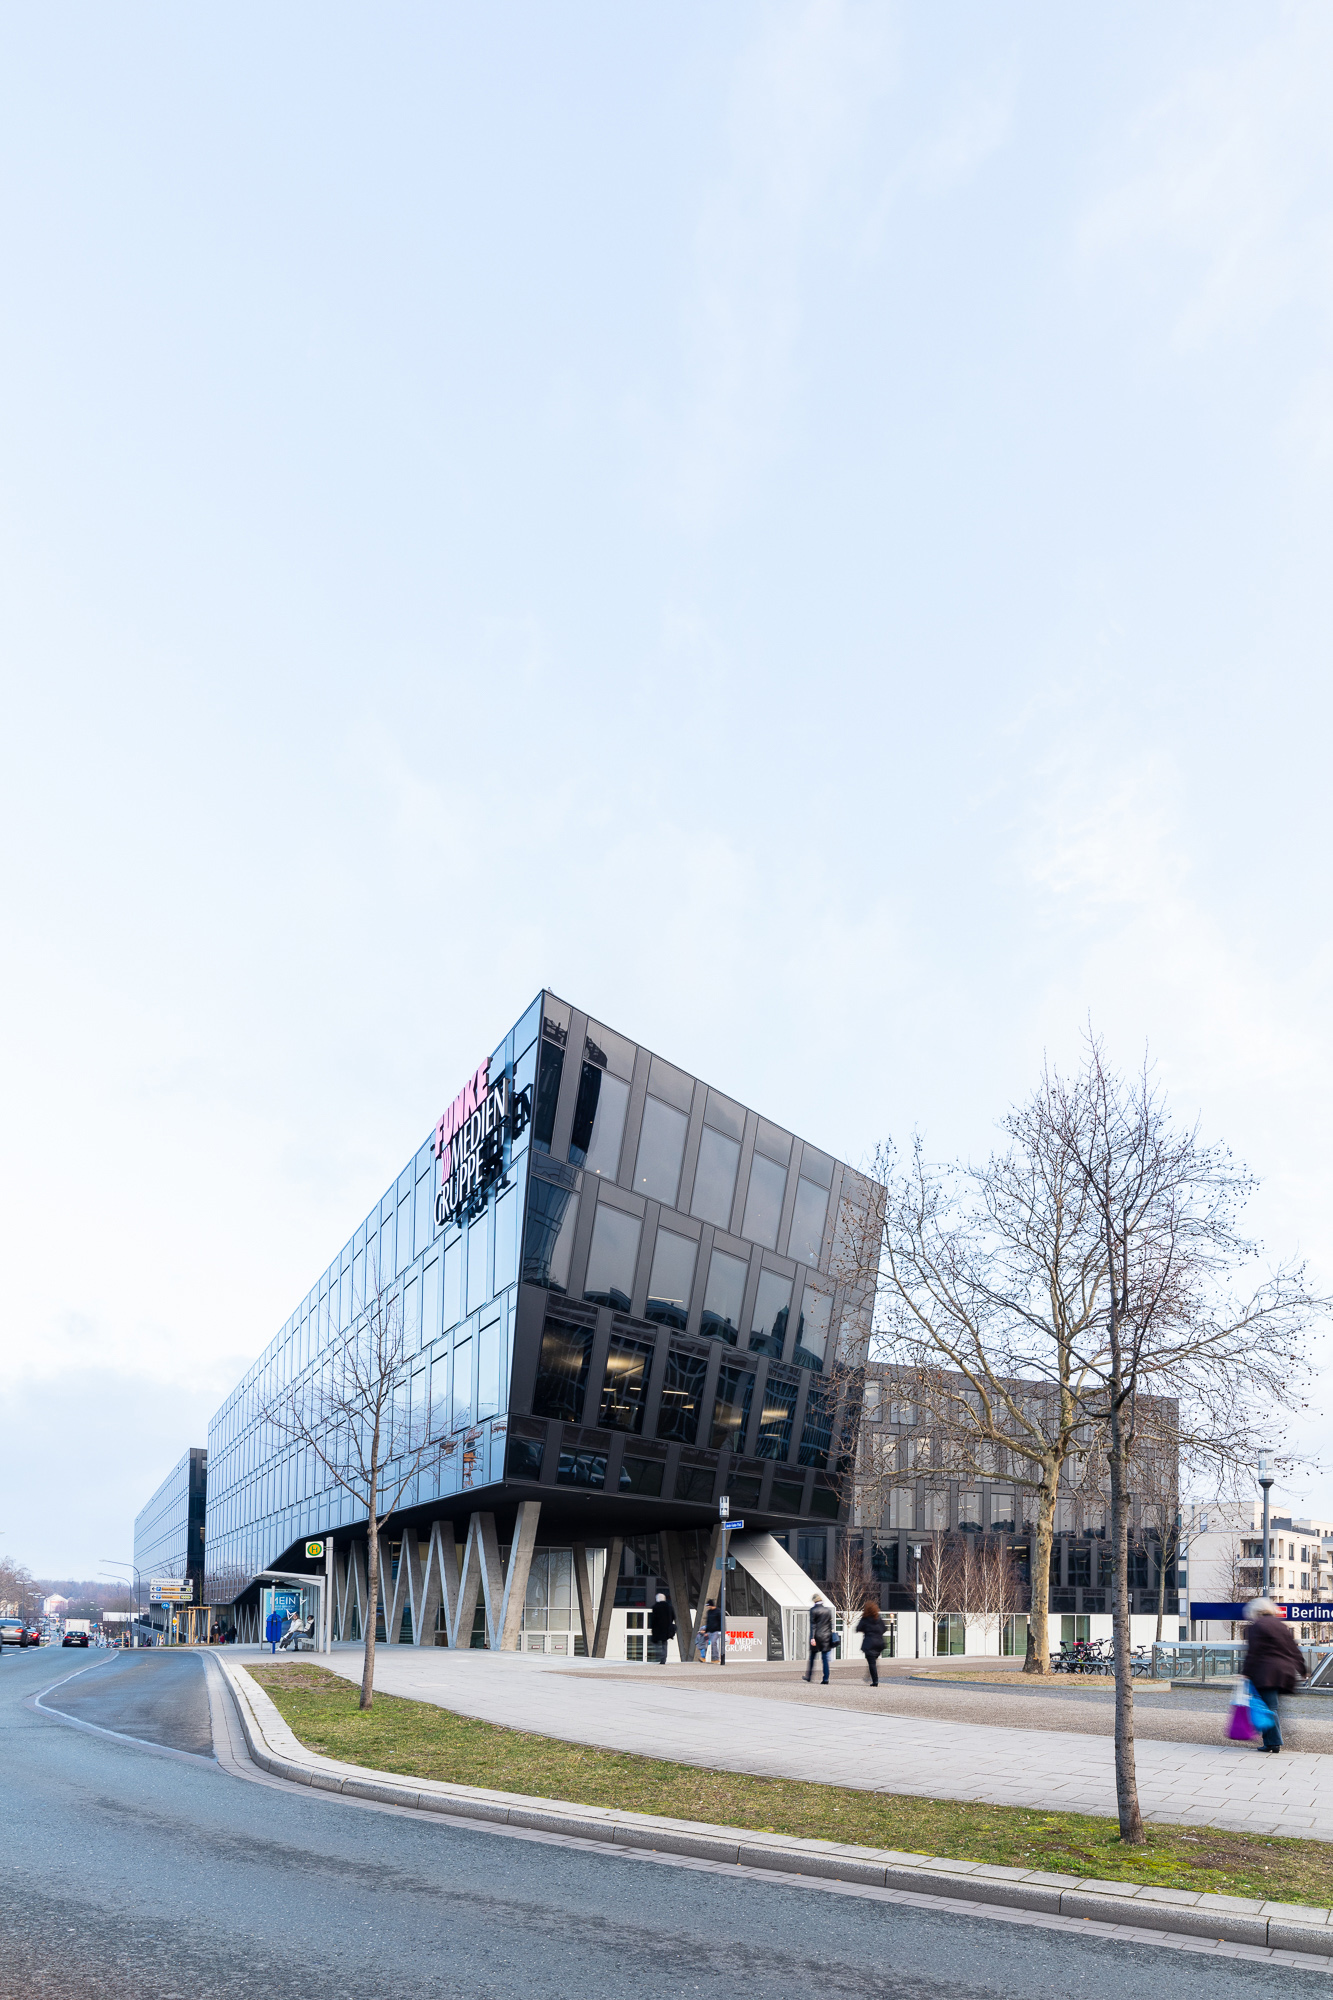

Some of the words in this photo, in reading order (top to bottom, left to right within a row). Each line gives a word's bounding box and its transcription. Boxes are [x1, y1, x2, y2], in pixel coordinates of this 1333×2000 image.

[435, 1057, 490, 1158] FUNKE
[451, 1078, 505, 1171] MEDIEN
[434, 1143, 484, 1225] GRUPPE
[269, 1596, 296, 1605] MEIN
[725, 1644, 753, 1652] GRUPPE
[734, 1638, 763, 1646] MEDIEN
